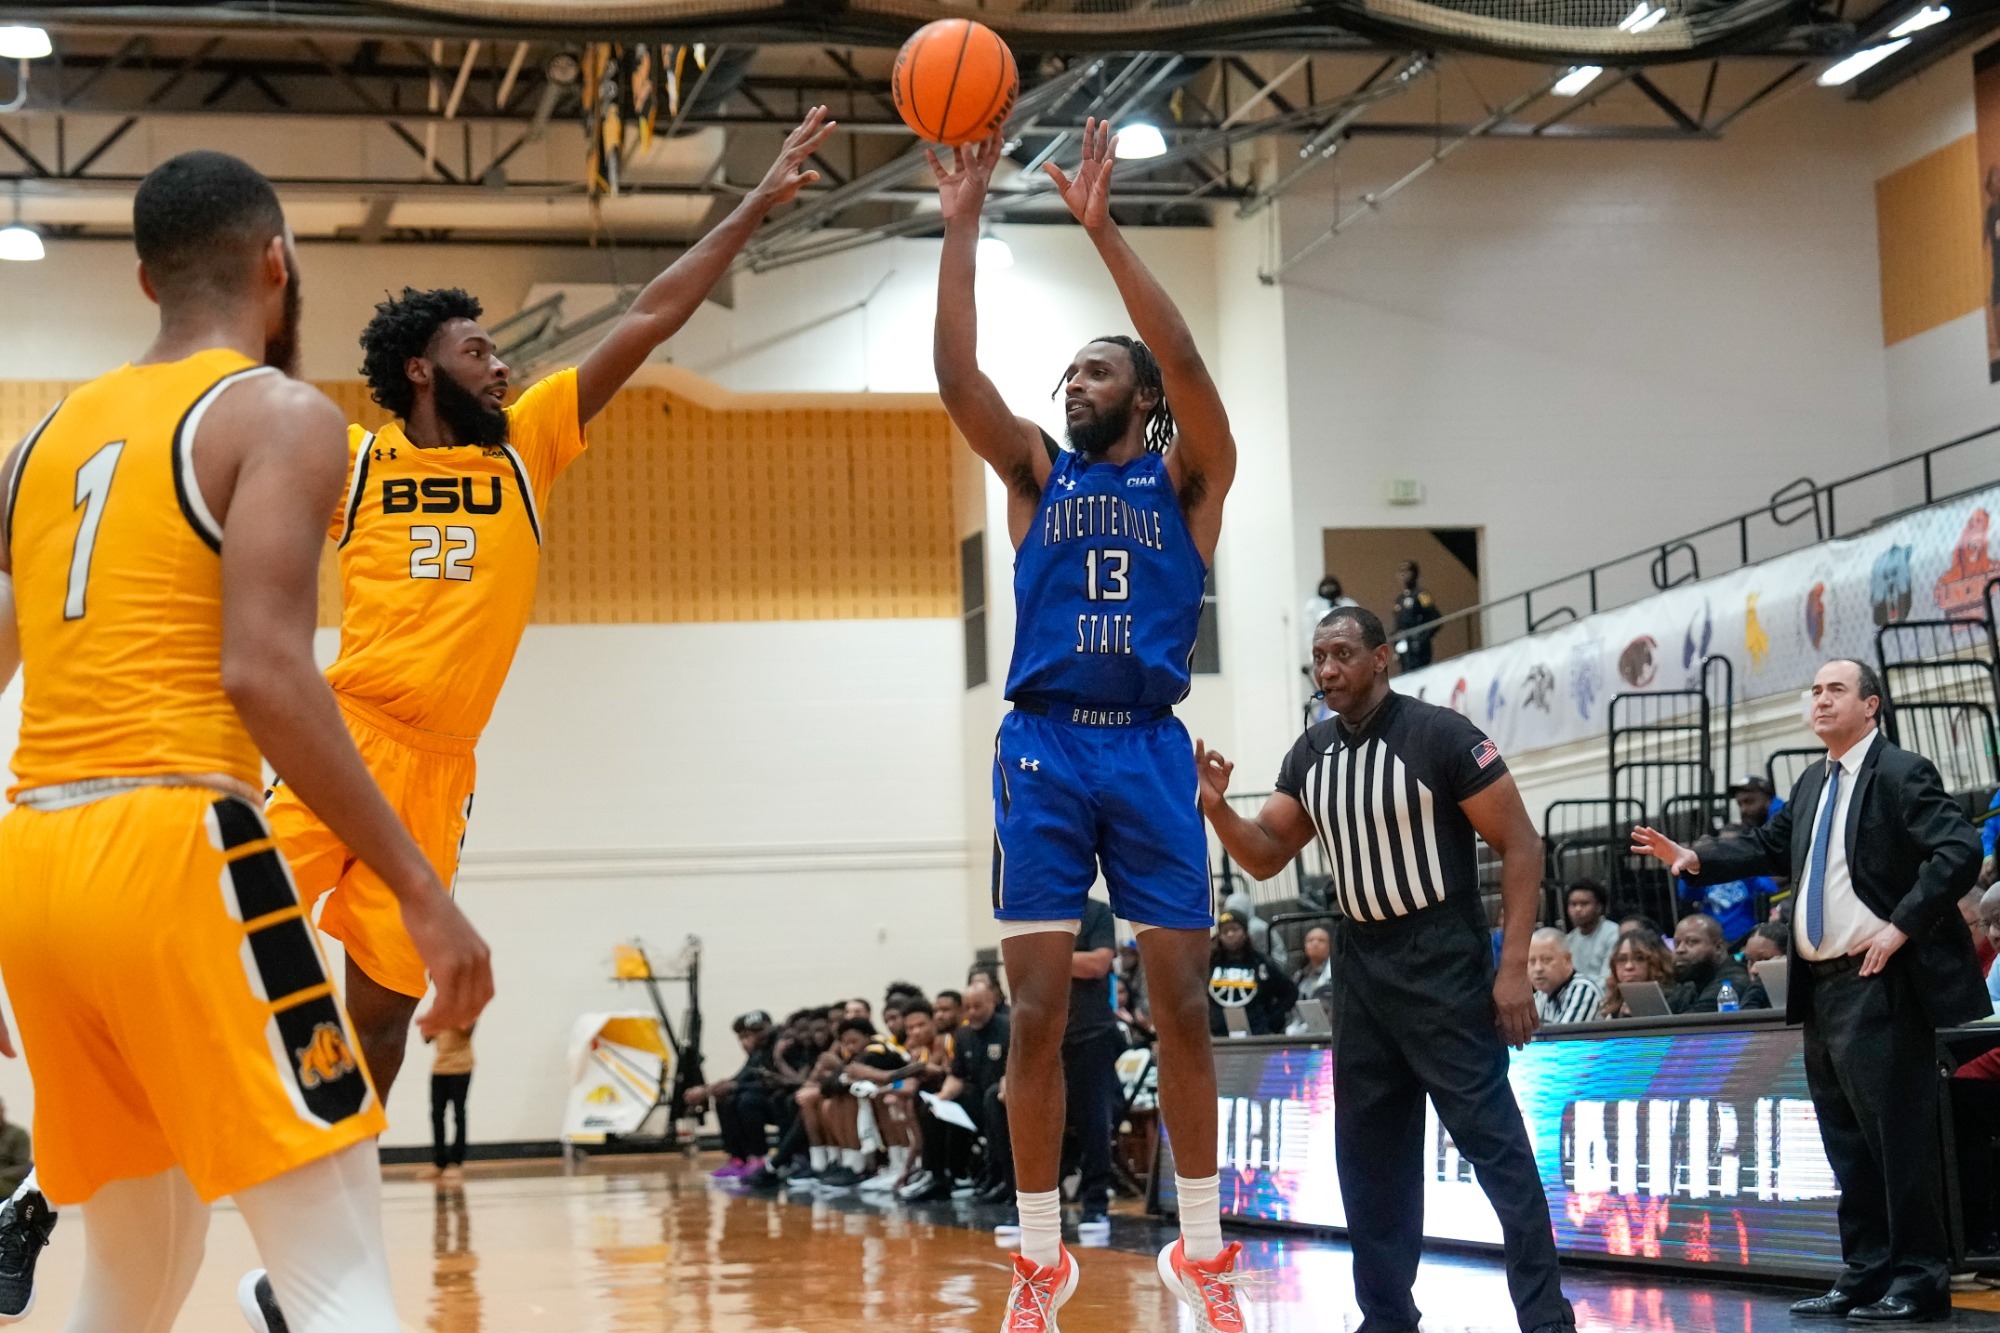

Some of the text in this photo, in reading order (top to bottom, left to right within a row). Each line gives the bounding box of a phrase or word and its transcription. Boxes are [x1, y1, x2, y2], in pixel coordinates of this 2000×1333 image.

[382, 476, 502, 515] BSU
[1126, 476, 1156, 488] CIAA
[64, 439, 126, 621] 1
[1043, 494, 1163, 551] FAYETTEVILLE
[409, 525, 477, 582] 22
[1085, 549, 1130, 601] 13
[1076, 614, 1133, 654] STATE
[1072, 708, 1132, 725] BRONCOS
